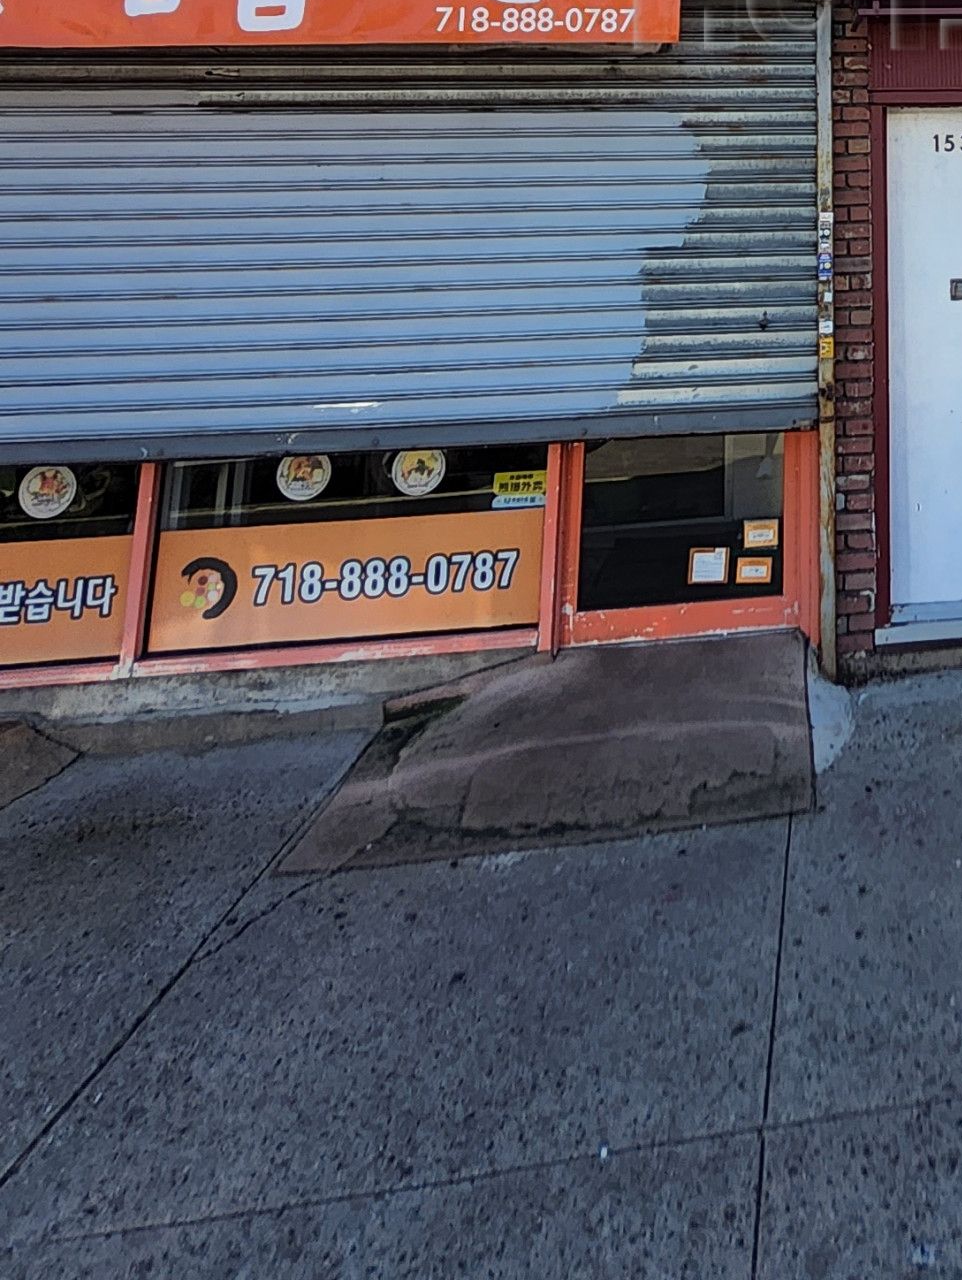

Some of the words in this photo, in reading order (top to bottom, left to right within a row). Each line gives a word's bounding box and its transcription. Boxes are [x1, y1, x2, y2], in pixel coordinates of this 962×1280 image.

[435, 5, 636, 34] 718-888-0787
[0, 574, 118, 624] 받습니다
[252, 548, 519, 607] 718-888-0787
